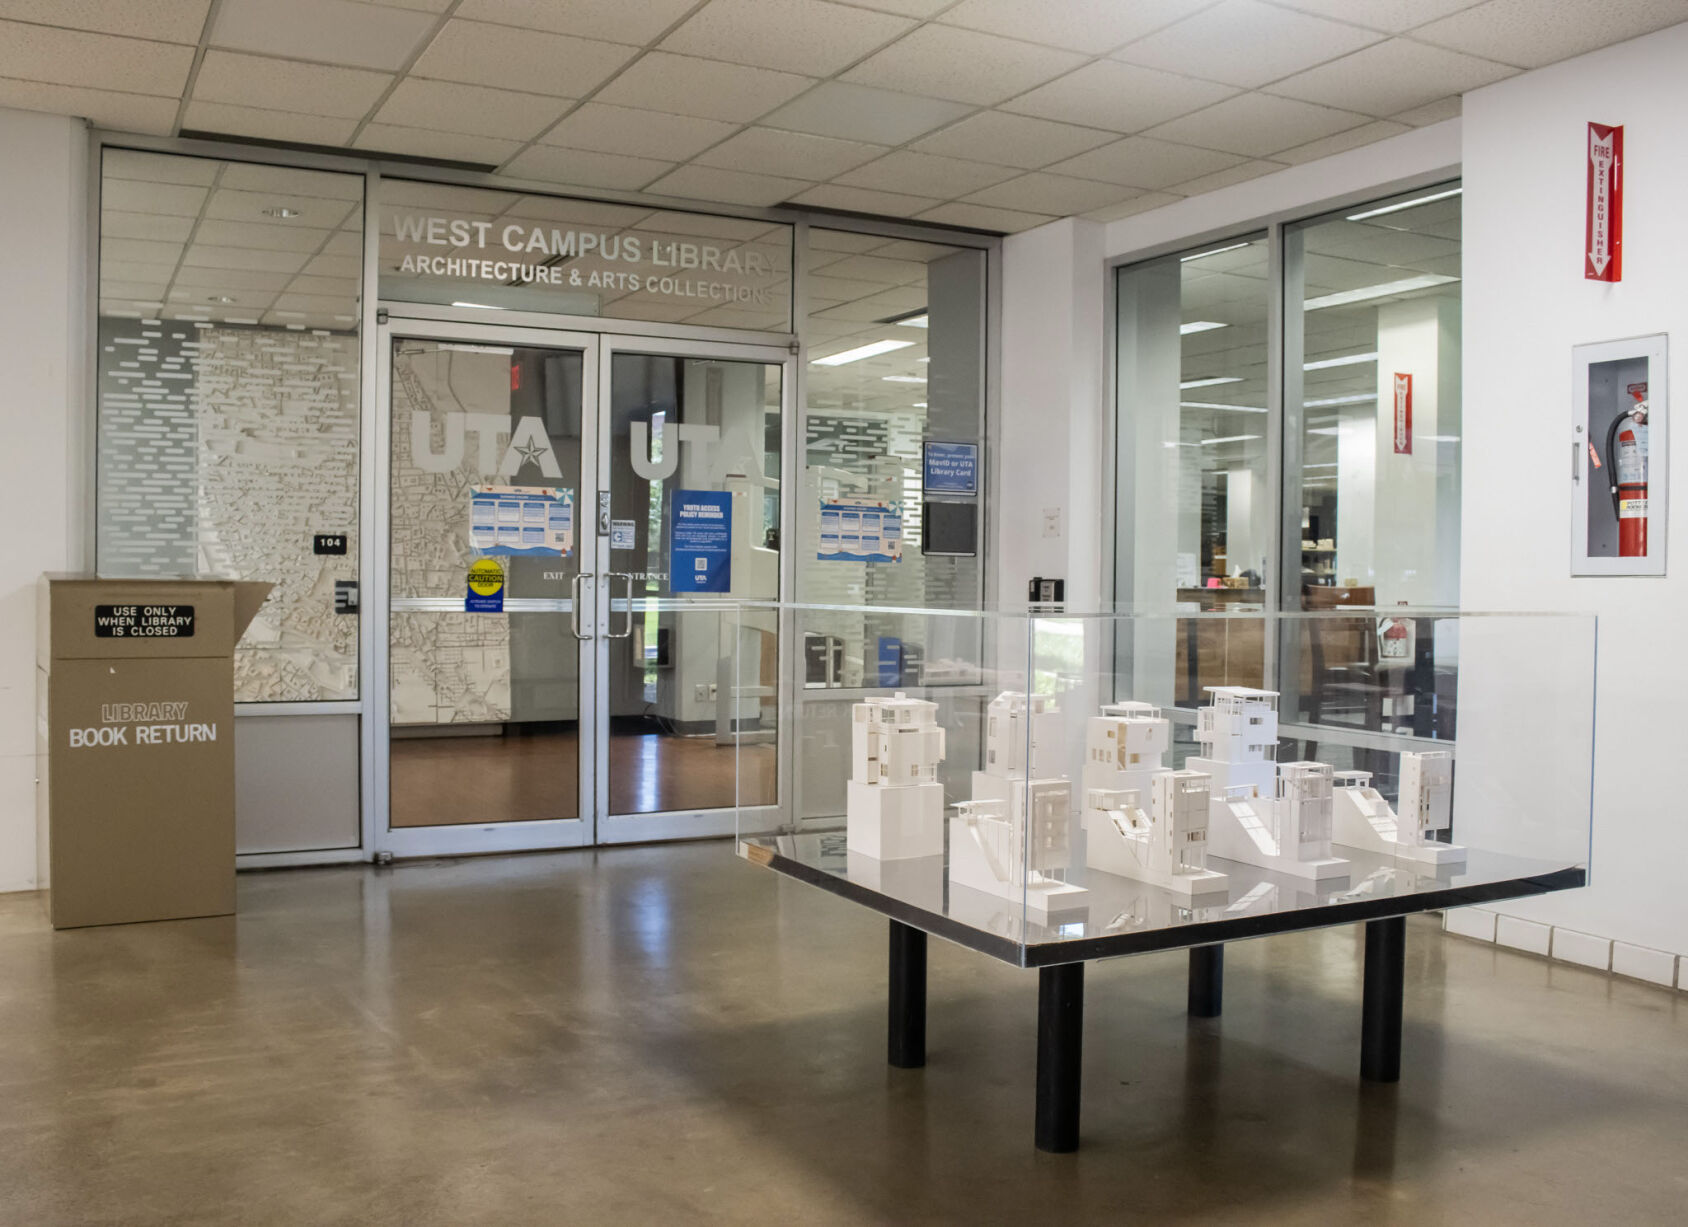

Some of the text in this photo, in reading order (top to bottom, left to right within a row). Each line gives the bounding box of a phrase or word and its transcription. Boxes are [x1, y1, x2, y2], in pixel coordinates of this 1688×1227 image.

[1594, 145, 1610, 159] FIRE
[1596, 160, 1605, 265] EXTINGUISHER
[393, 214, 779, 277] WEST CAMPUS LIBRARY
[401, 254, 775, 305] ARCHITECTURE & ARTS COLLECTIONS
[411, 410, 564, 479] UTA
[930, 468, 972, 477] Library Card
[320, 538, 341, 547] 104
[543, 571, 565, 580] EXIT
[622, 572, 669, 581] NTRANCE
[113, 606, 176, 616] USE ONLY
[98, 616, 192, 626] WHEN LIBRARY
[112, 626, 178, 636] IS CLOSED
[102, 702, 188, 723] LIBRARY
[69, 723, 217, 748] BOOK RETURN
